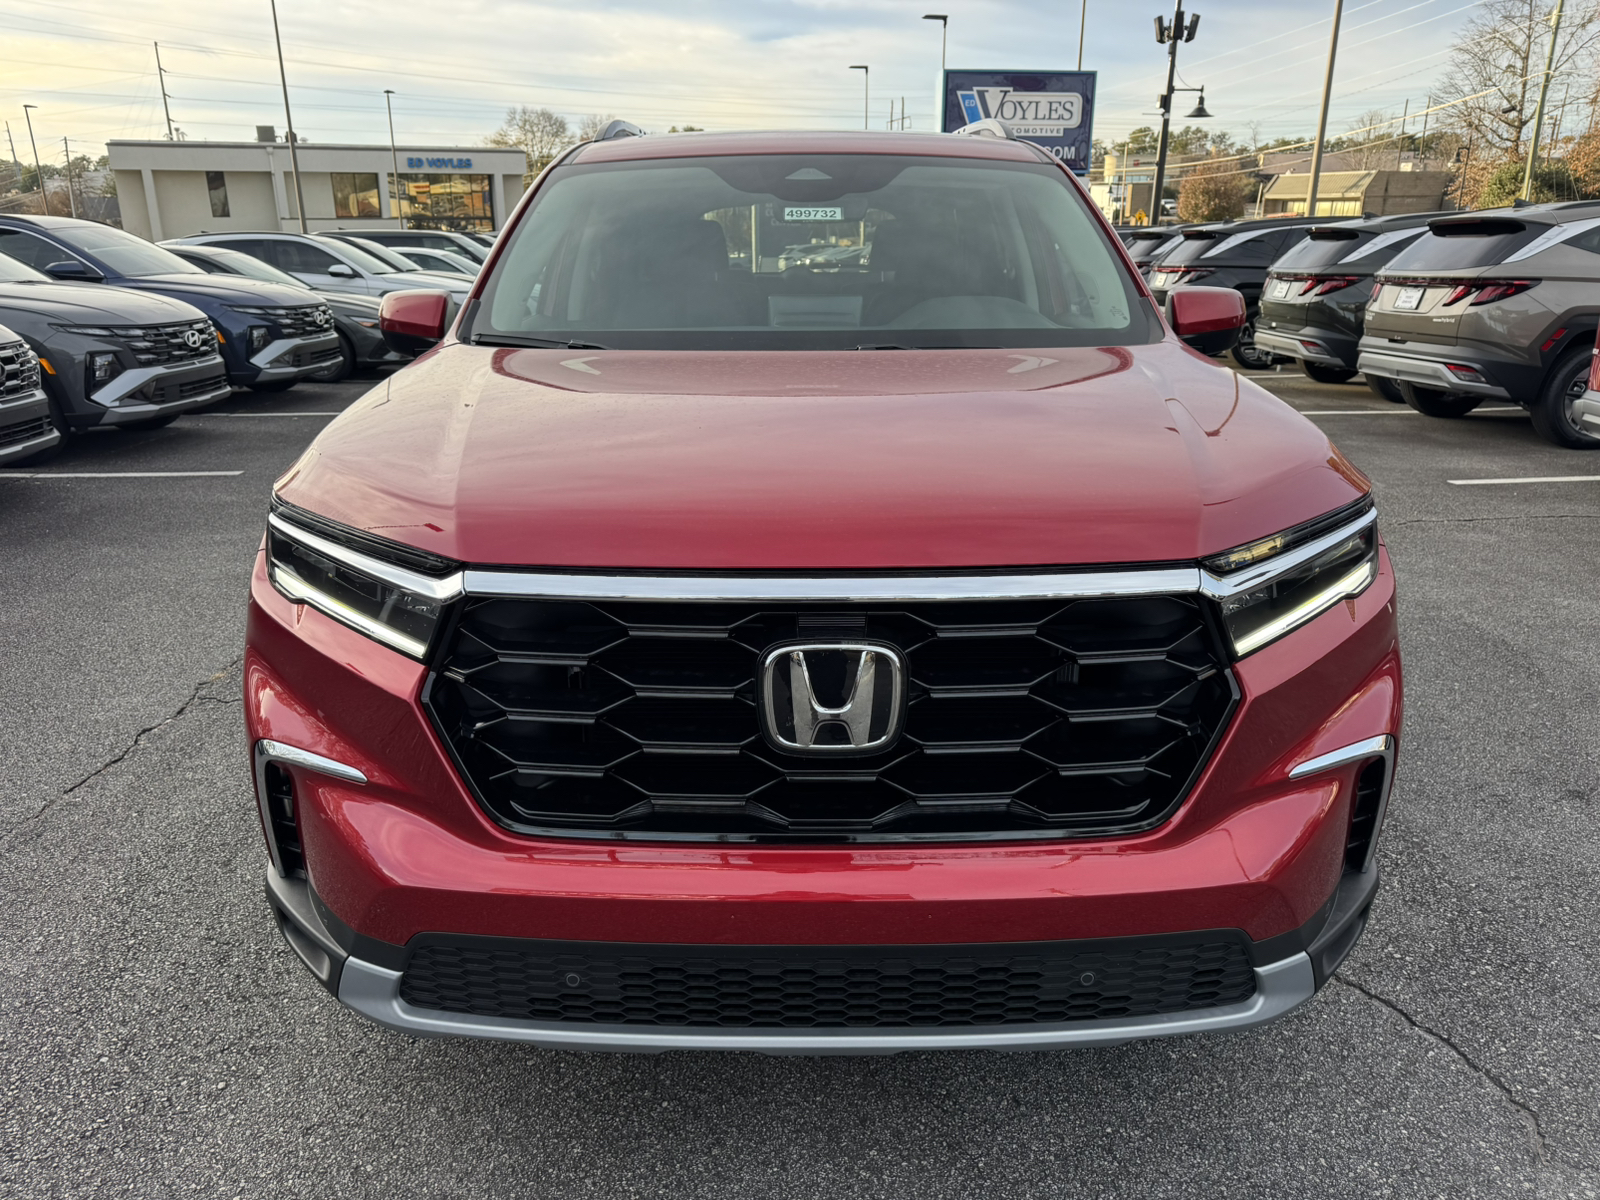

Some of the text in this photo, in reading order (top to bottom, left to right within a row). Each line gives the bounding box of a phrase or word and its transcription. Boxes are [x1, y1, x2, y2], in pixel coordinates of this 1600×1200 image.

[965, 89, 1075, 121] ED VOYLES
[407, 157, 473, 169] ED VOYLES
[786, 209, 838, 218] 499732
